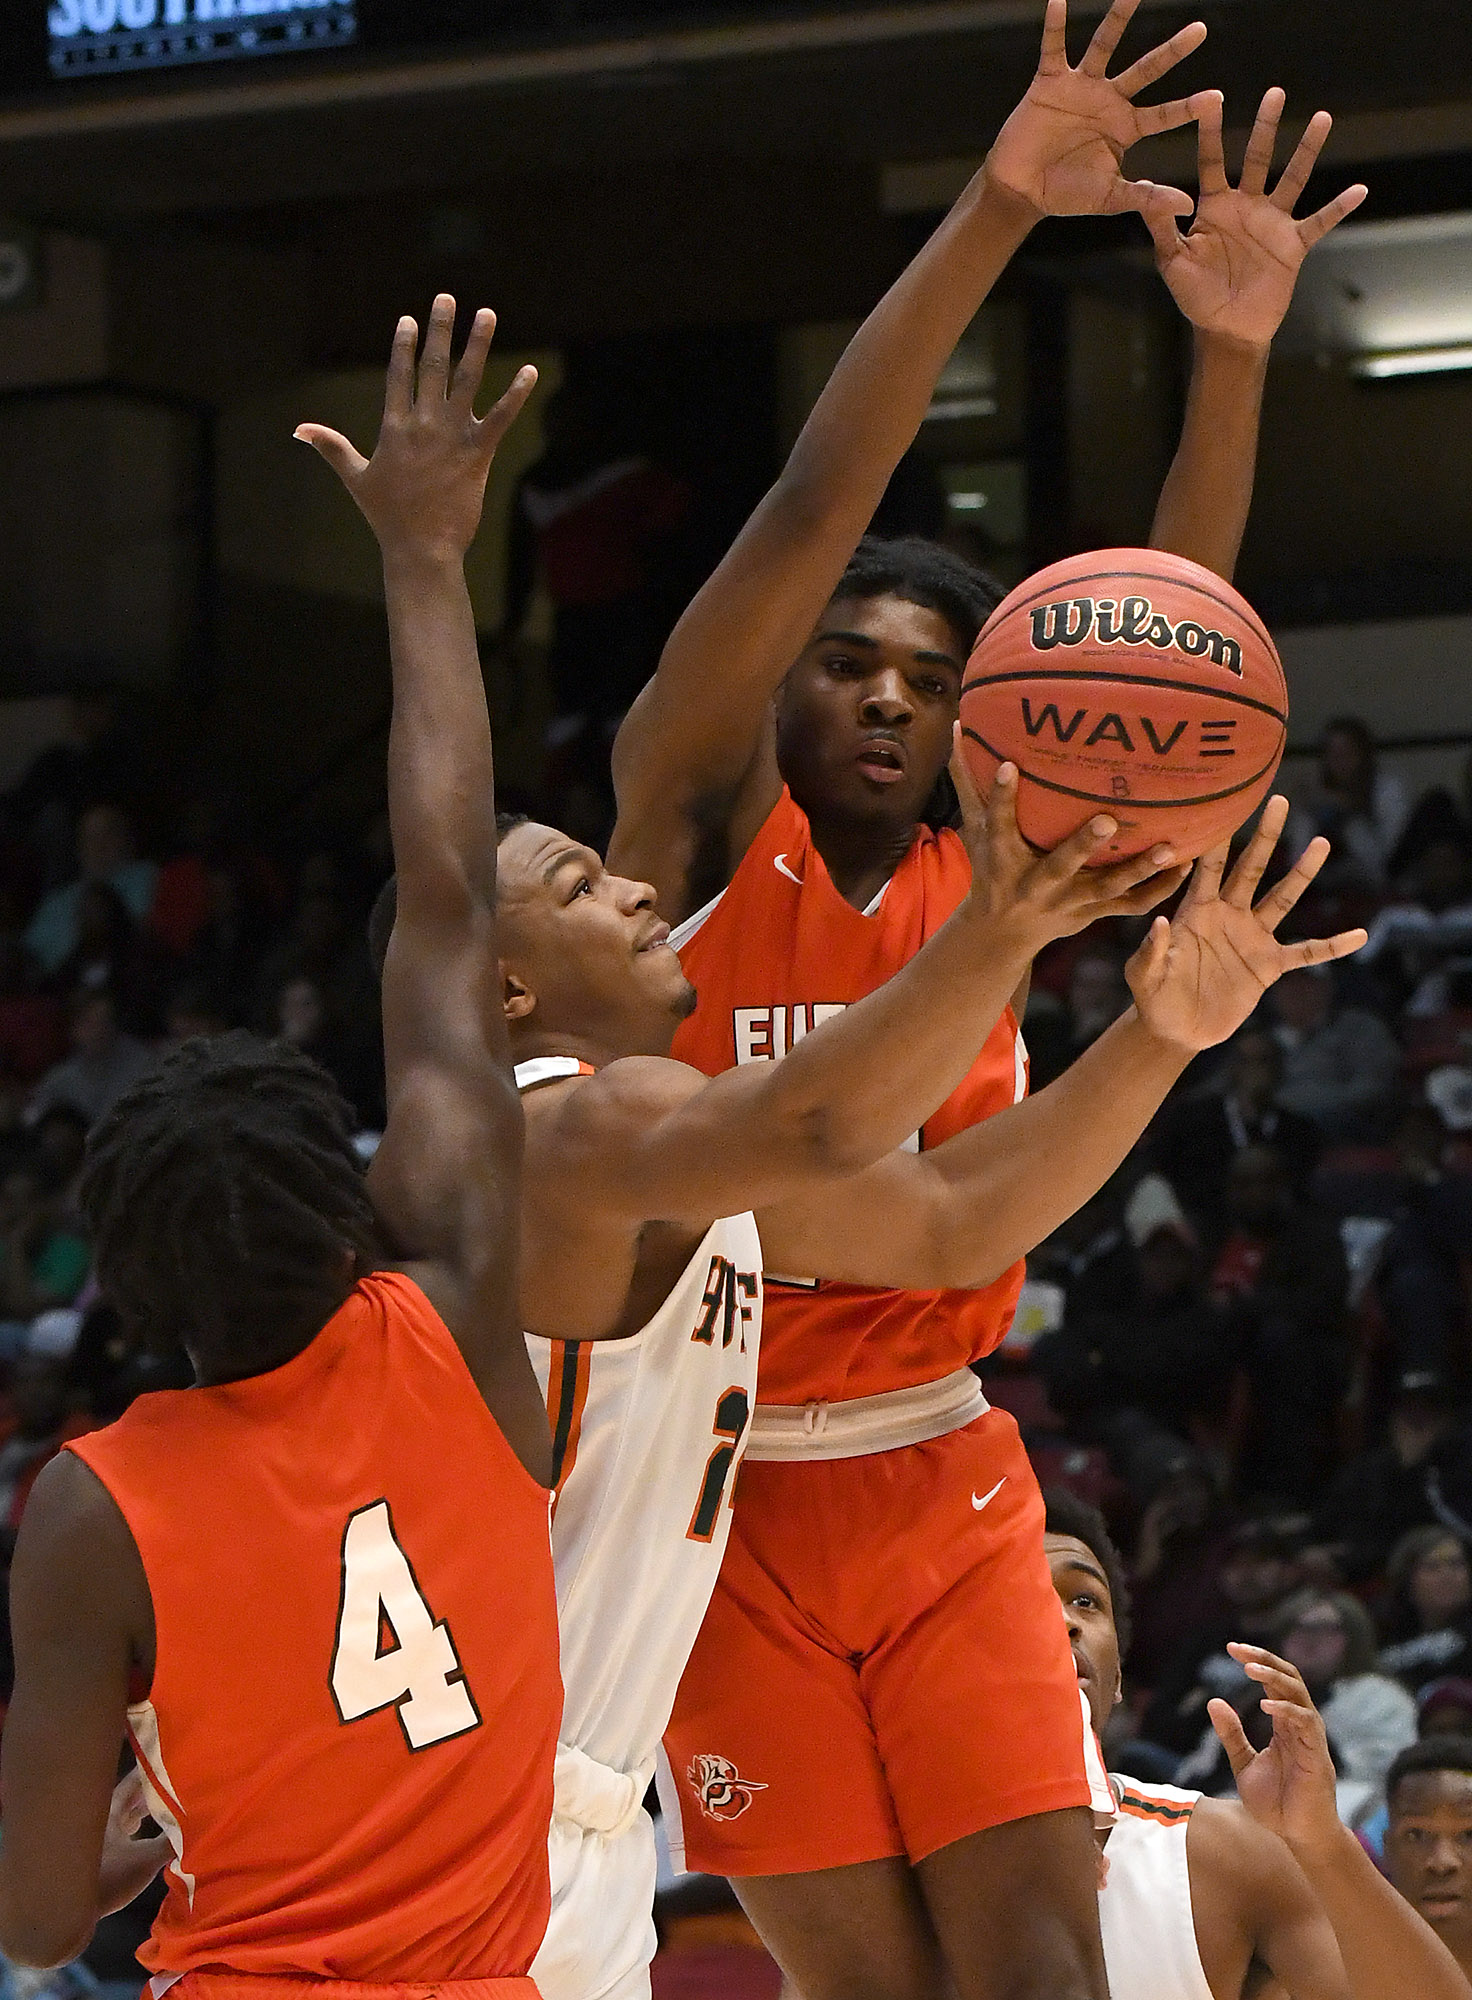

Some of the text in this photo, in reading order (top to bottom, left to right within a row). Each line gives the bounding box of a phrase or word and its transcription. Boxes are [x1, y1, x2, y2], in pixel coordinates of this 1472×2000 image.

[1029, 595, 1244, 680] Wilson
[1021, 697, 1238, 757] WAVE
[328, 1496, 483, 1754] 4
